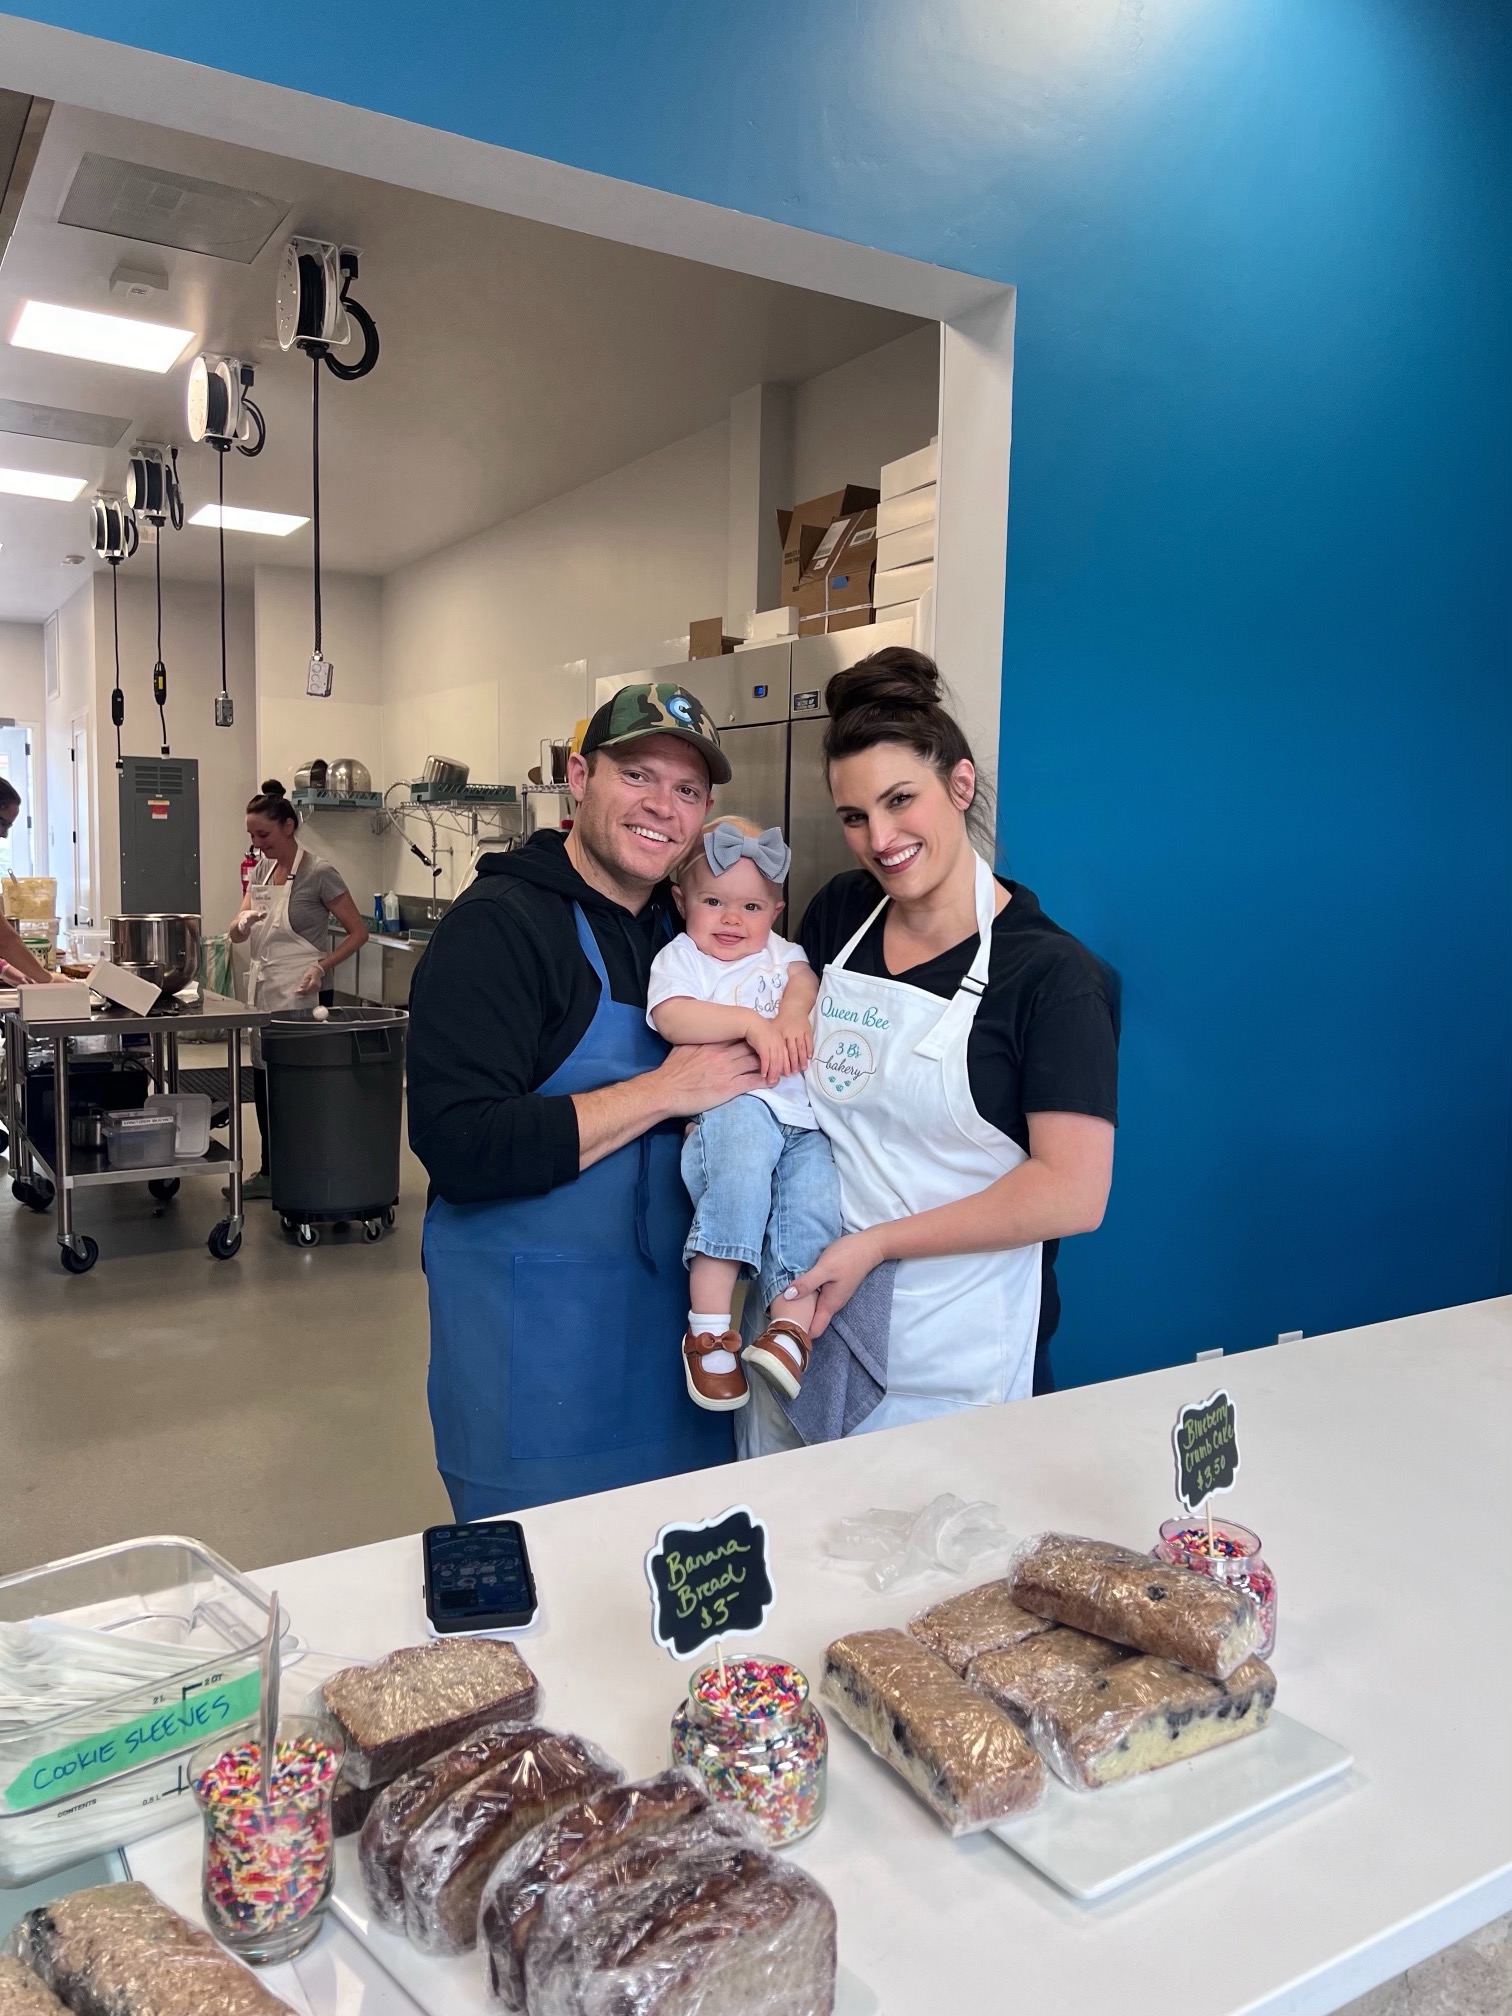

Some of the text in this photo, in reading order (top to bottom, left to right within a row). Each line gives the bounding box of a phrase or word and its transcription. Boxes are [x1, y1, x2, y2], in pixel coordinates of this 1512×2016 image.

[820, 996, 890, 1030] Queen Bee
[835, 1042, 845, 1056] 3
[819, 1055, 872, 1081] bakery
[1183, 1403, 1229, 1450] Blueberry
[1212, 1424, 1234, 1449] Cake
[1196, 1455, 1226, 1491] $3.50
[666, 1539, 751, 1591] Banana
[676, 1563, 746, 1619] Bread
[33, 1694, 231, 1790] COOKIE SLEEVES
[57, 1798, 97, 1818] CONTENTS
